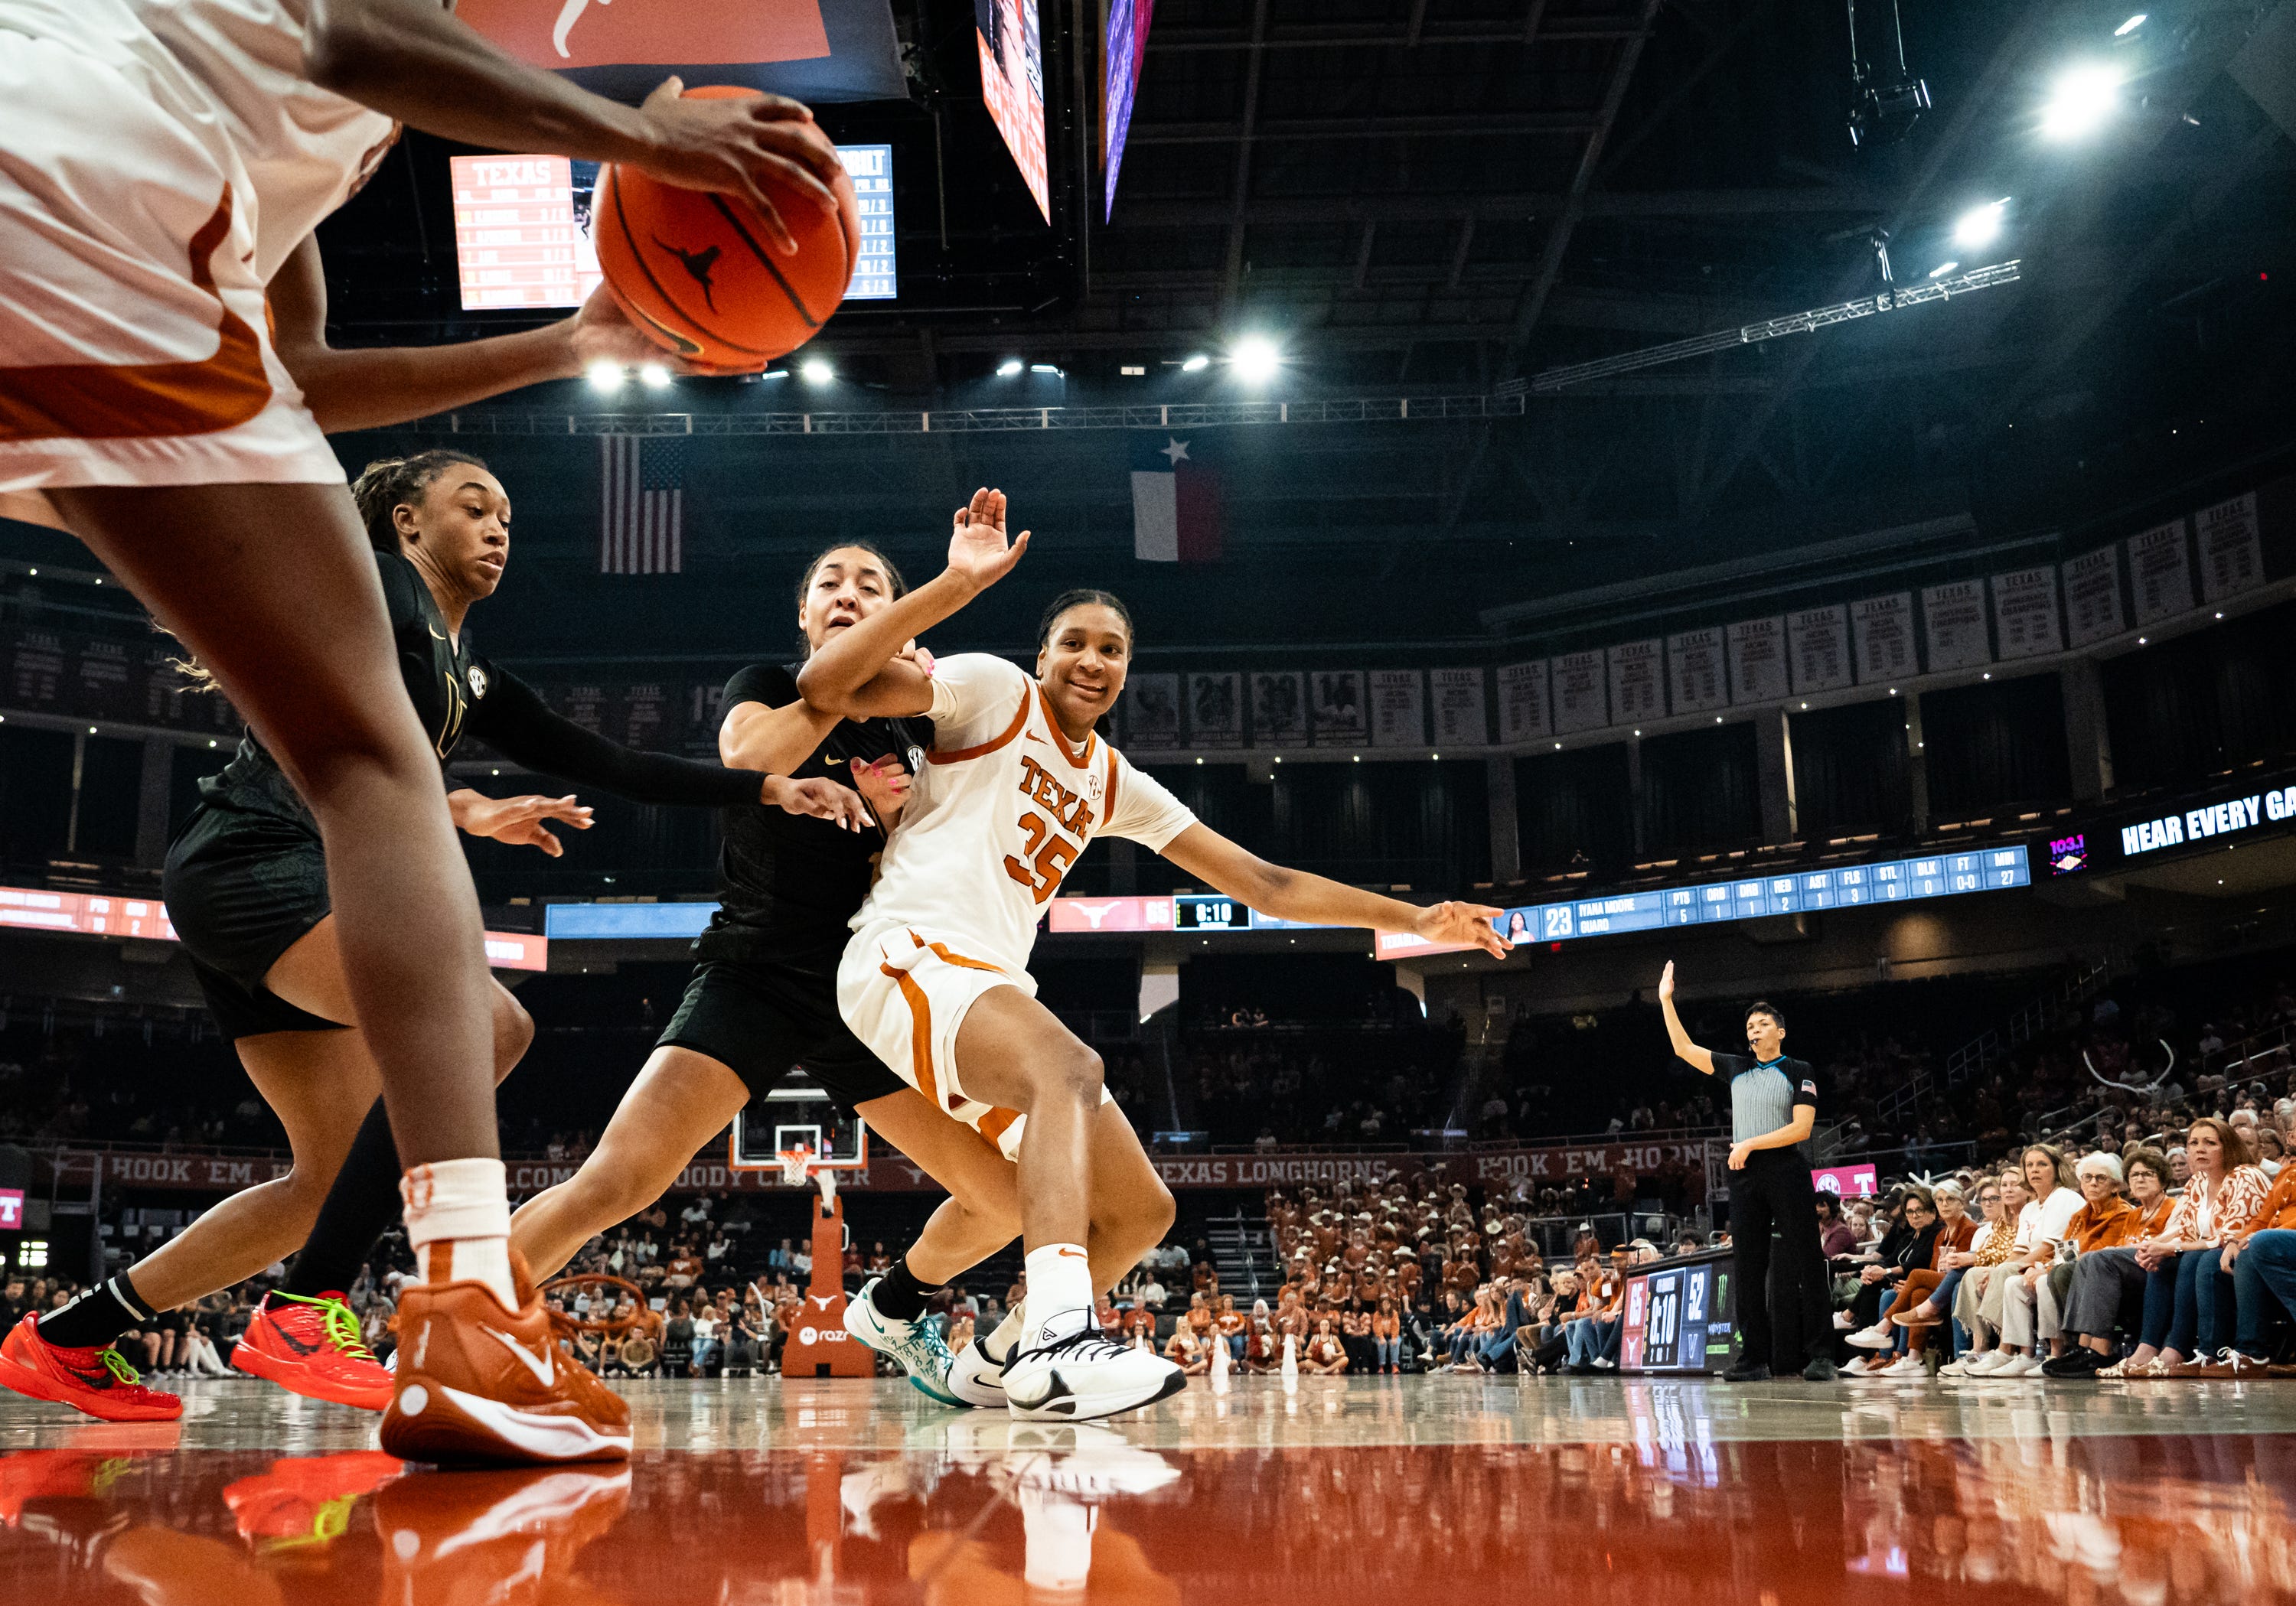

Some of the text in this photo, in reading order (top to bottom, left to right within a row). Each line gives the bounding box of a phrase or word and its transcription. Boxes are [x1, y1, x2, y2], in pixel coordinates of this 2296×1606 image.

[471, 161, 552, 186] TEXAS
[2122, 816, 2183, 855] HEAR
[2186, 795, 2260, 840] EVERY
[2050, 834, 2084, 855] 103.1
[1003, 812, 1078, 905] 35
[1957, 857, 1969, 871] FT
[1994, 851, 2015, 867] MIN
[1880, 866, 1897, 881] STL
[1916, 861, 1936, 876] BLK
[1809, 875, 1827, 889] AST
[1844, 871, 1861, 884] FLS
[1957, 875, 1975, 890] 0-0
[2001, 870, 2014, 885] 27
[1707, 887, 1726, 901] ORB
[1774, 880, 1792, 894] REB
[1887, 884, 1895, 898] 0
[1925, 880, 1932, 894] 0
[1673, 891, 1690, 905] PTS
[1782, 897, 1789, 911] 2
[1818, 893, 1822, 907] 1
[1147, 901, 1169, 924] 65
[1196, 903, 1231, 922] 8:10
[1579, 898, 1635, 917] IYANA MOORE
[1716, 905, 1720, 918] 1
[1750, 901, 1754, 915] 1
[131, 920, 140, 935] 2
[1546, 907, 1572, 936] 23
[1580, 918, 1609, 933] GUARD
[113, 1157, 192, 1182] HOOK
[1236, 1159, 1389, 1184] LONGHORNS
[1477, 1154, 1549, 1179] HOOK
[1854, 1172, 1874, 1199] T
[1688, 1272, 1704, 1321] 52
[1629, 1282, 1644, 1327] 65
[1649, 1293, 1677, 1345] 8:10
[819, 1330, 850, 1342] razr
[1707, 1322, 1731, 1336] MONSTER
